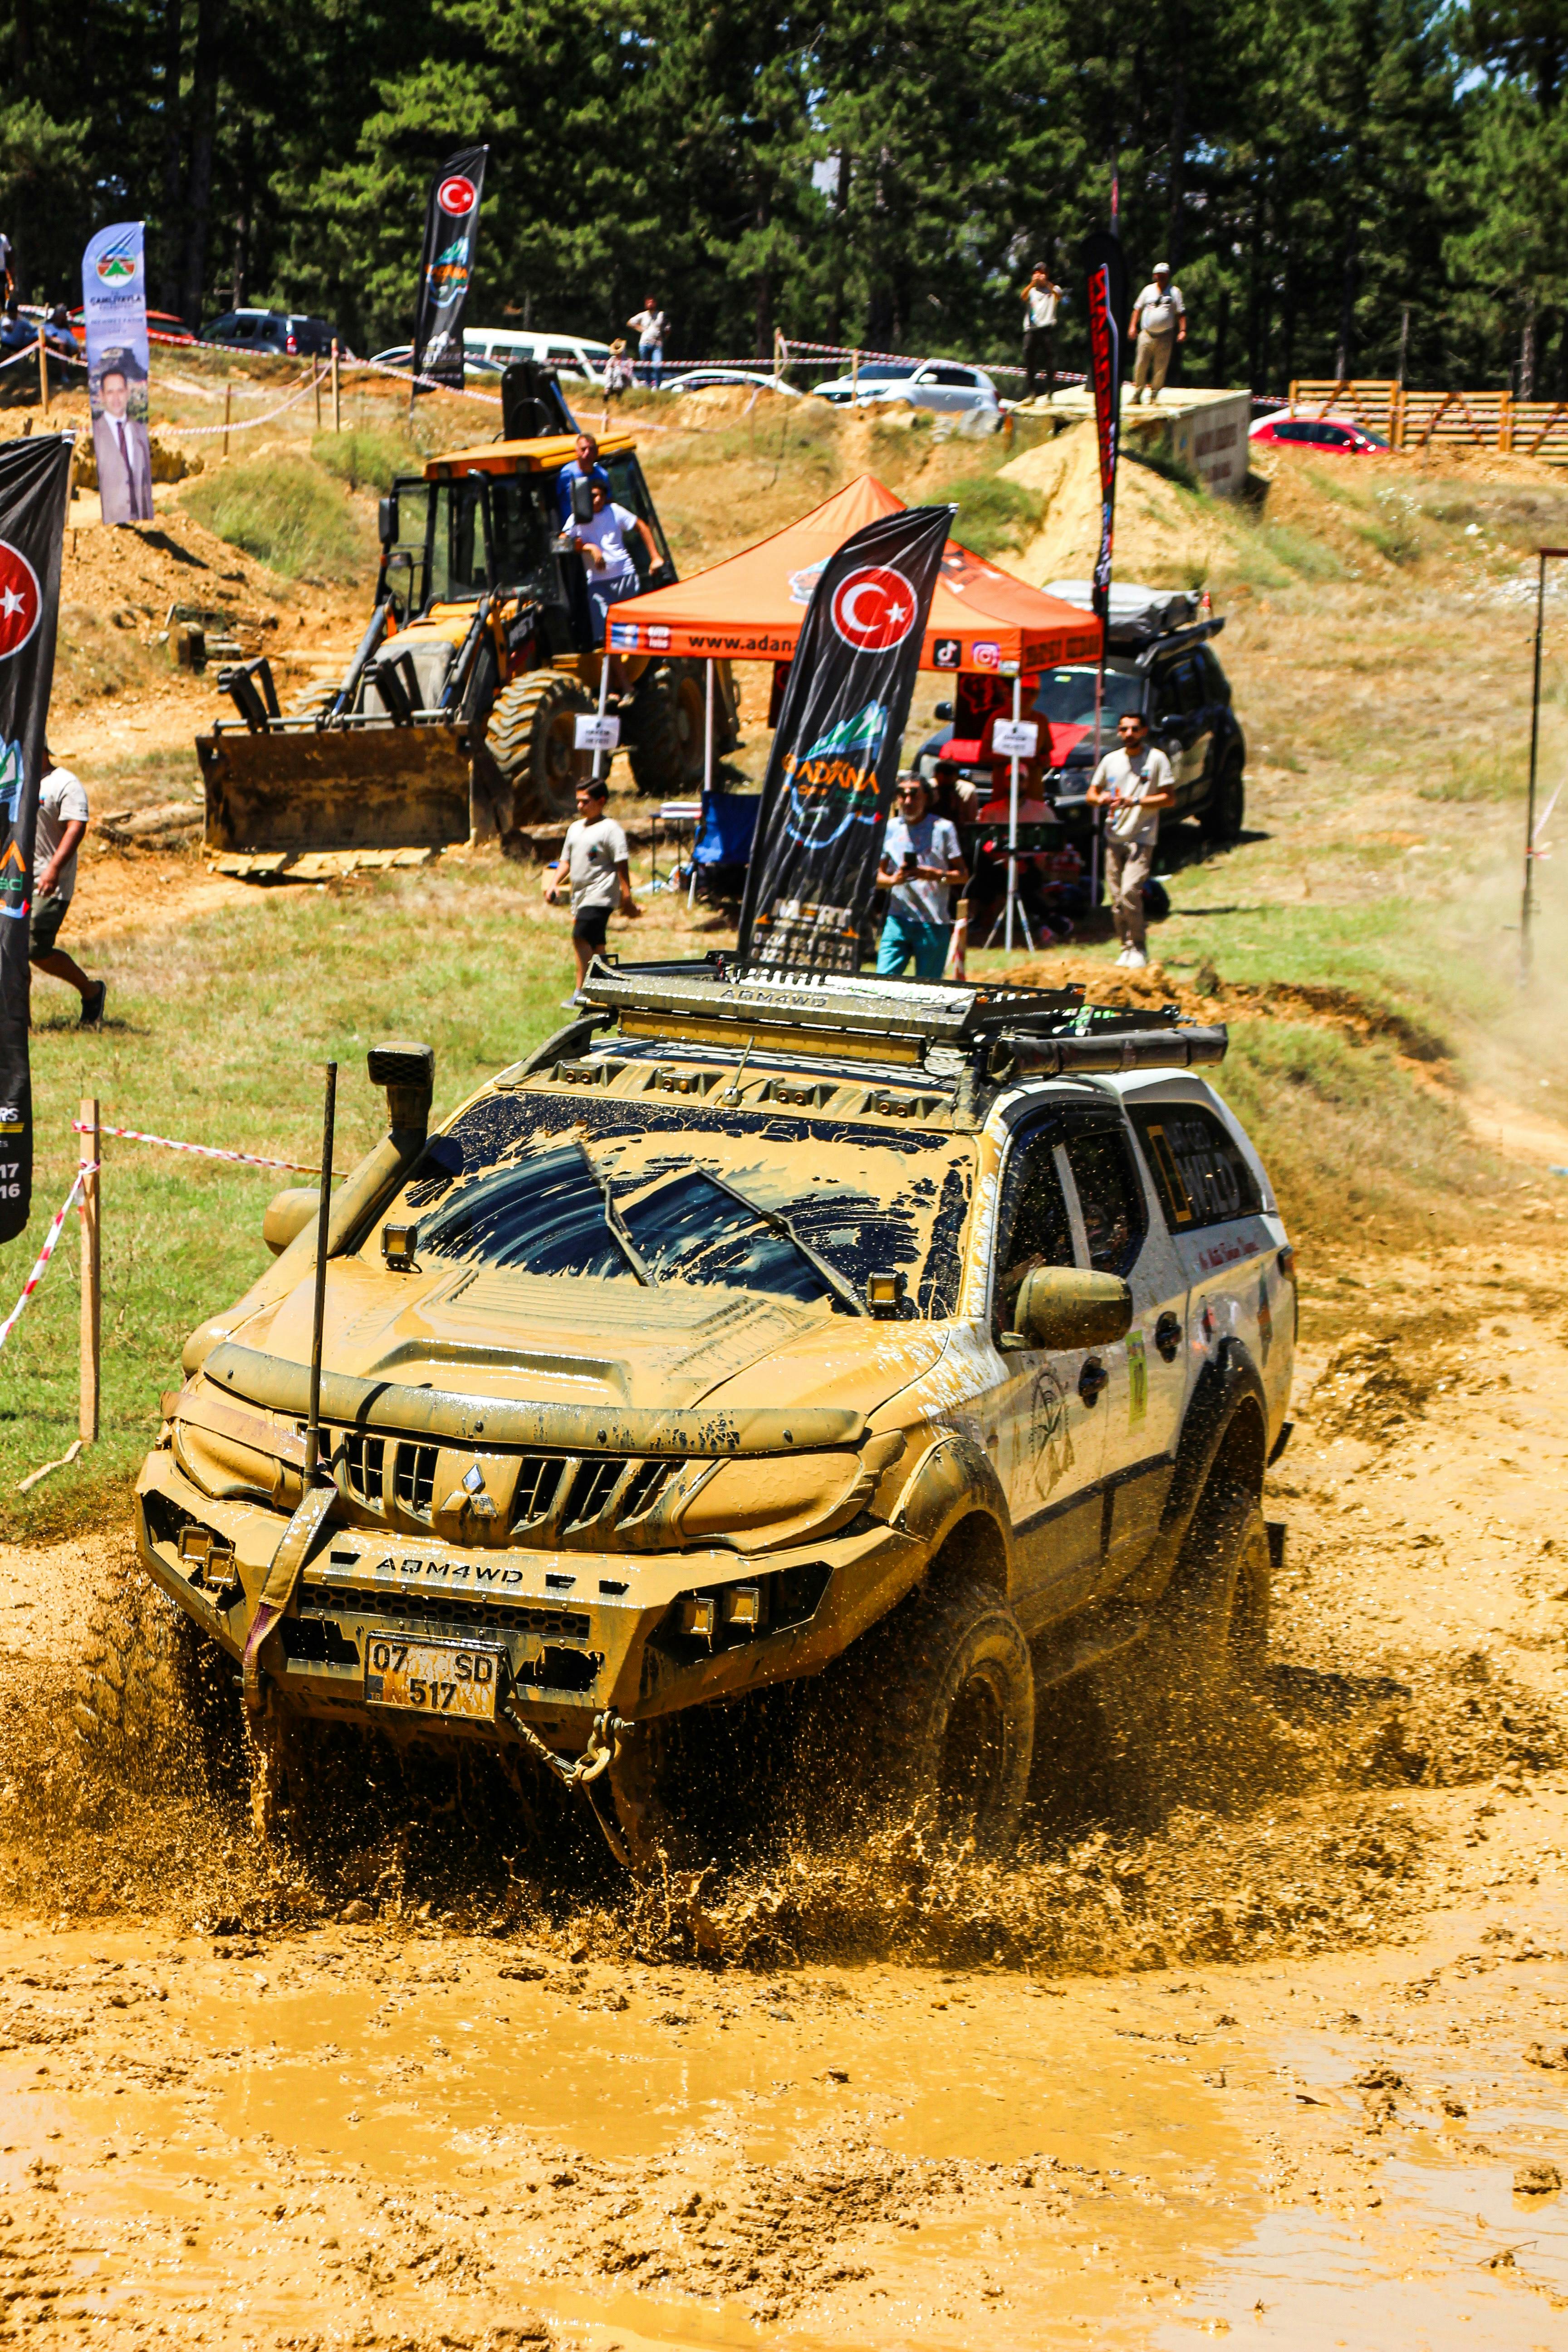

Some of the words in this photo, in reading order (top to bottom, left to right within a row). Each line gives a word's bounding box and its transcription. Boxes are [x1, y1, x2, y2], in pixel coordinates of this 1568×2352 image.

[795, 760, 881, 794] ADANA
[373, 1643, 408, 1672] 07
[455, 1653, 493, 1682] SD
[409, 1678, 457, 1710] 517
